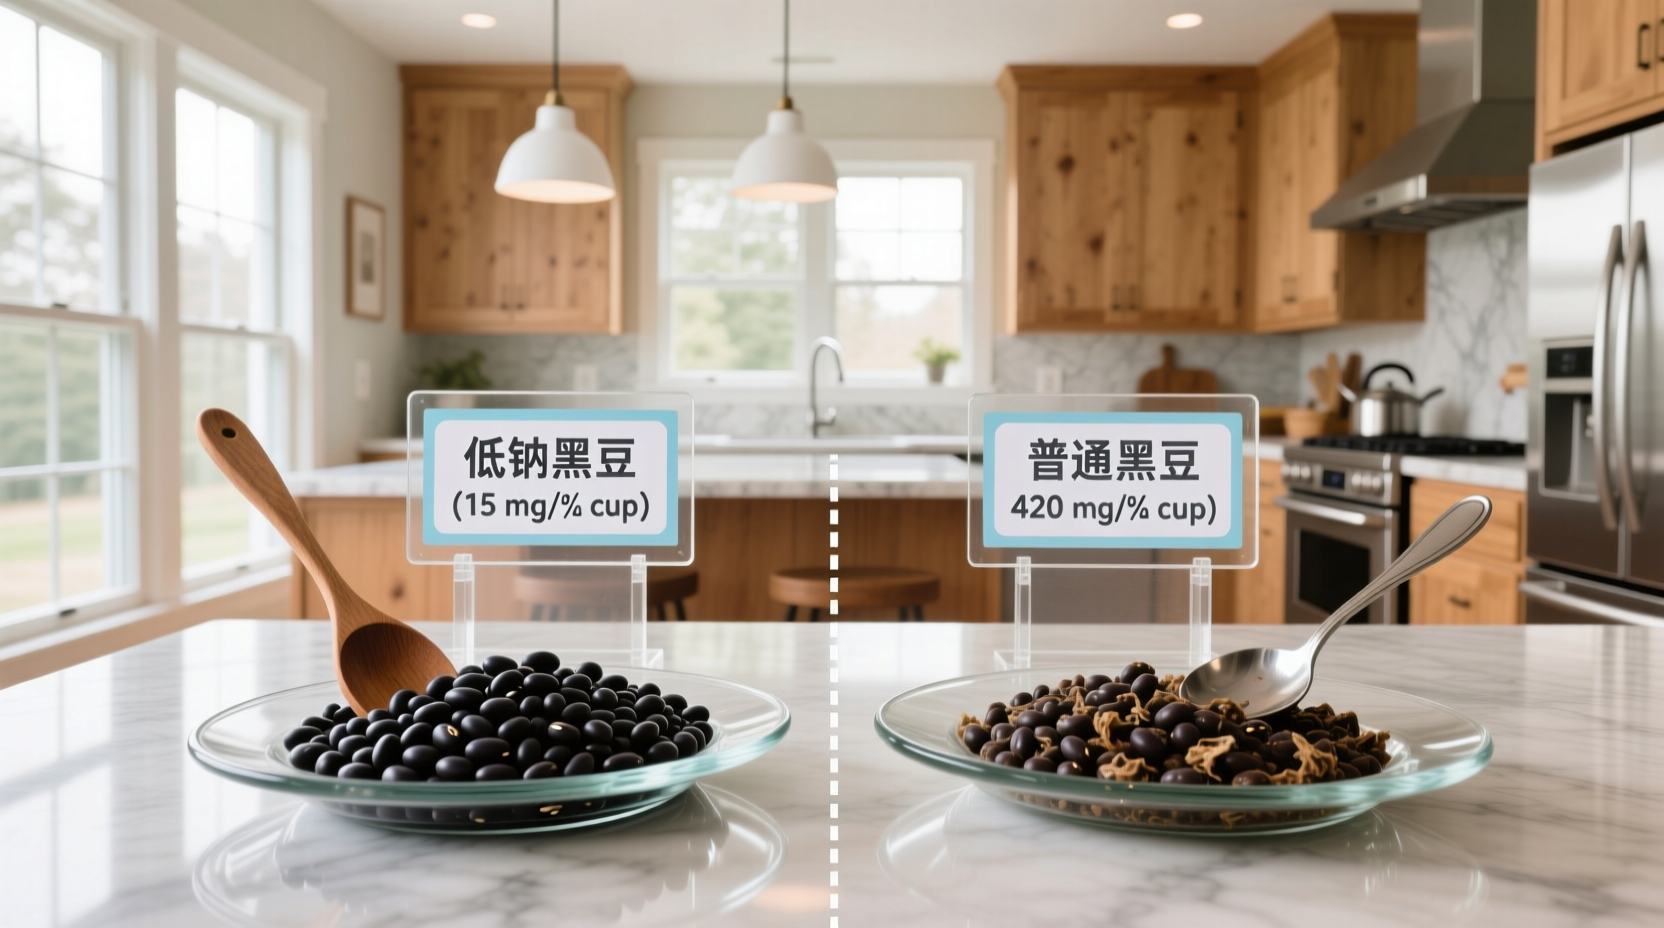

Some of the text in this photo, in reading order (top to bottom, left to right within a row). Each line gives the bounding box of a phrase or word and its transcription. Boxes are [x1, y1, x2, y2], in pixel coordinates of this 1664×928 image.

[463, 435, 636, 479] 低钠黑豆
[1028, 437, 1200, 481] 普通黑豆
[452, 490, 496, 522] (15
[590, 491, 650, 524] cup)
[1010, 494, 1064, 519] 420
[1157, 494, 1217, 526] cup)
